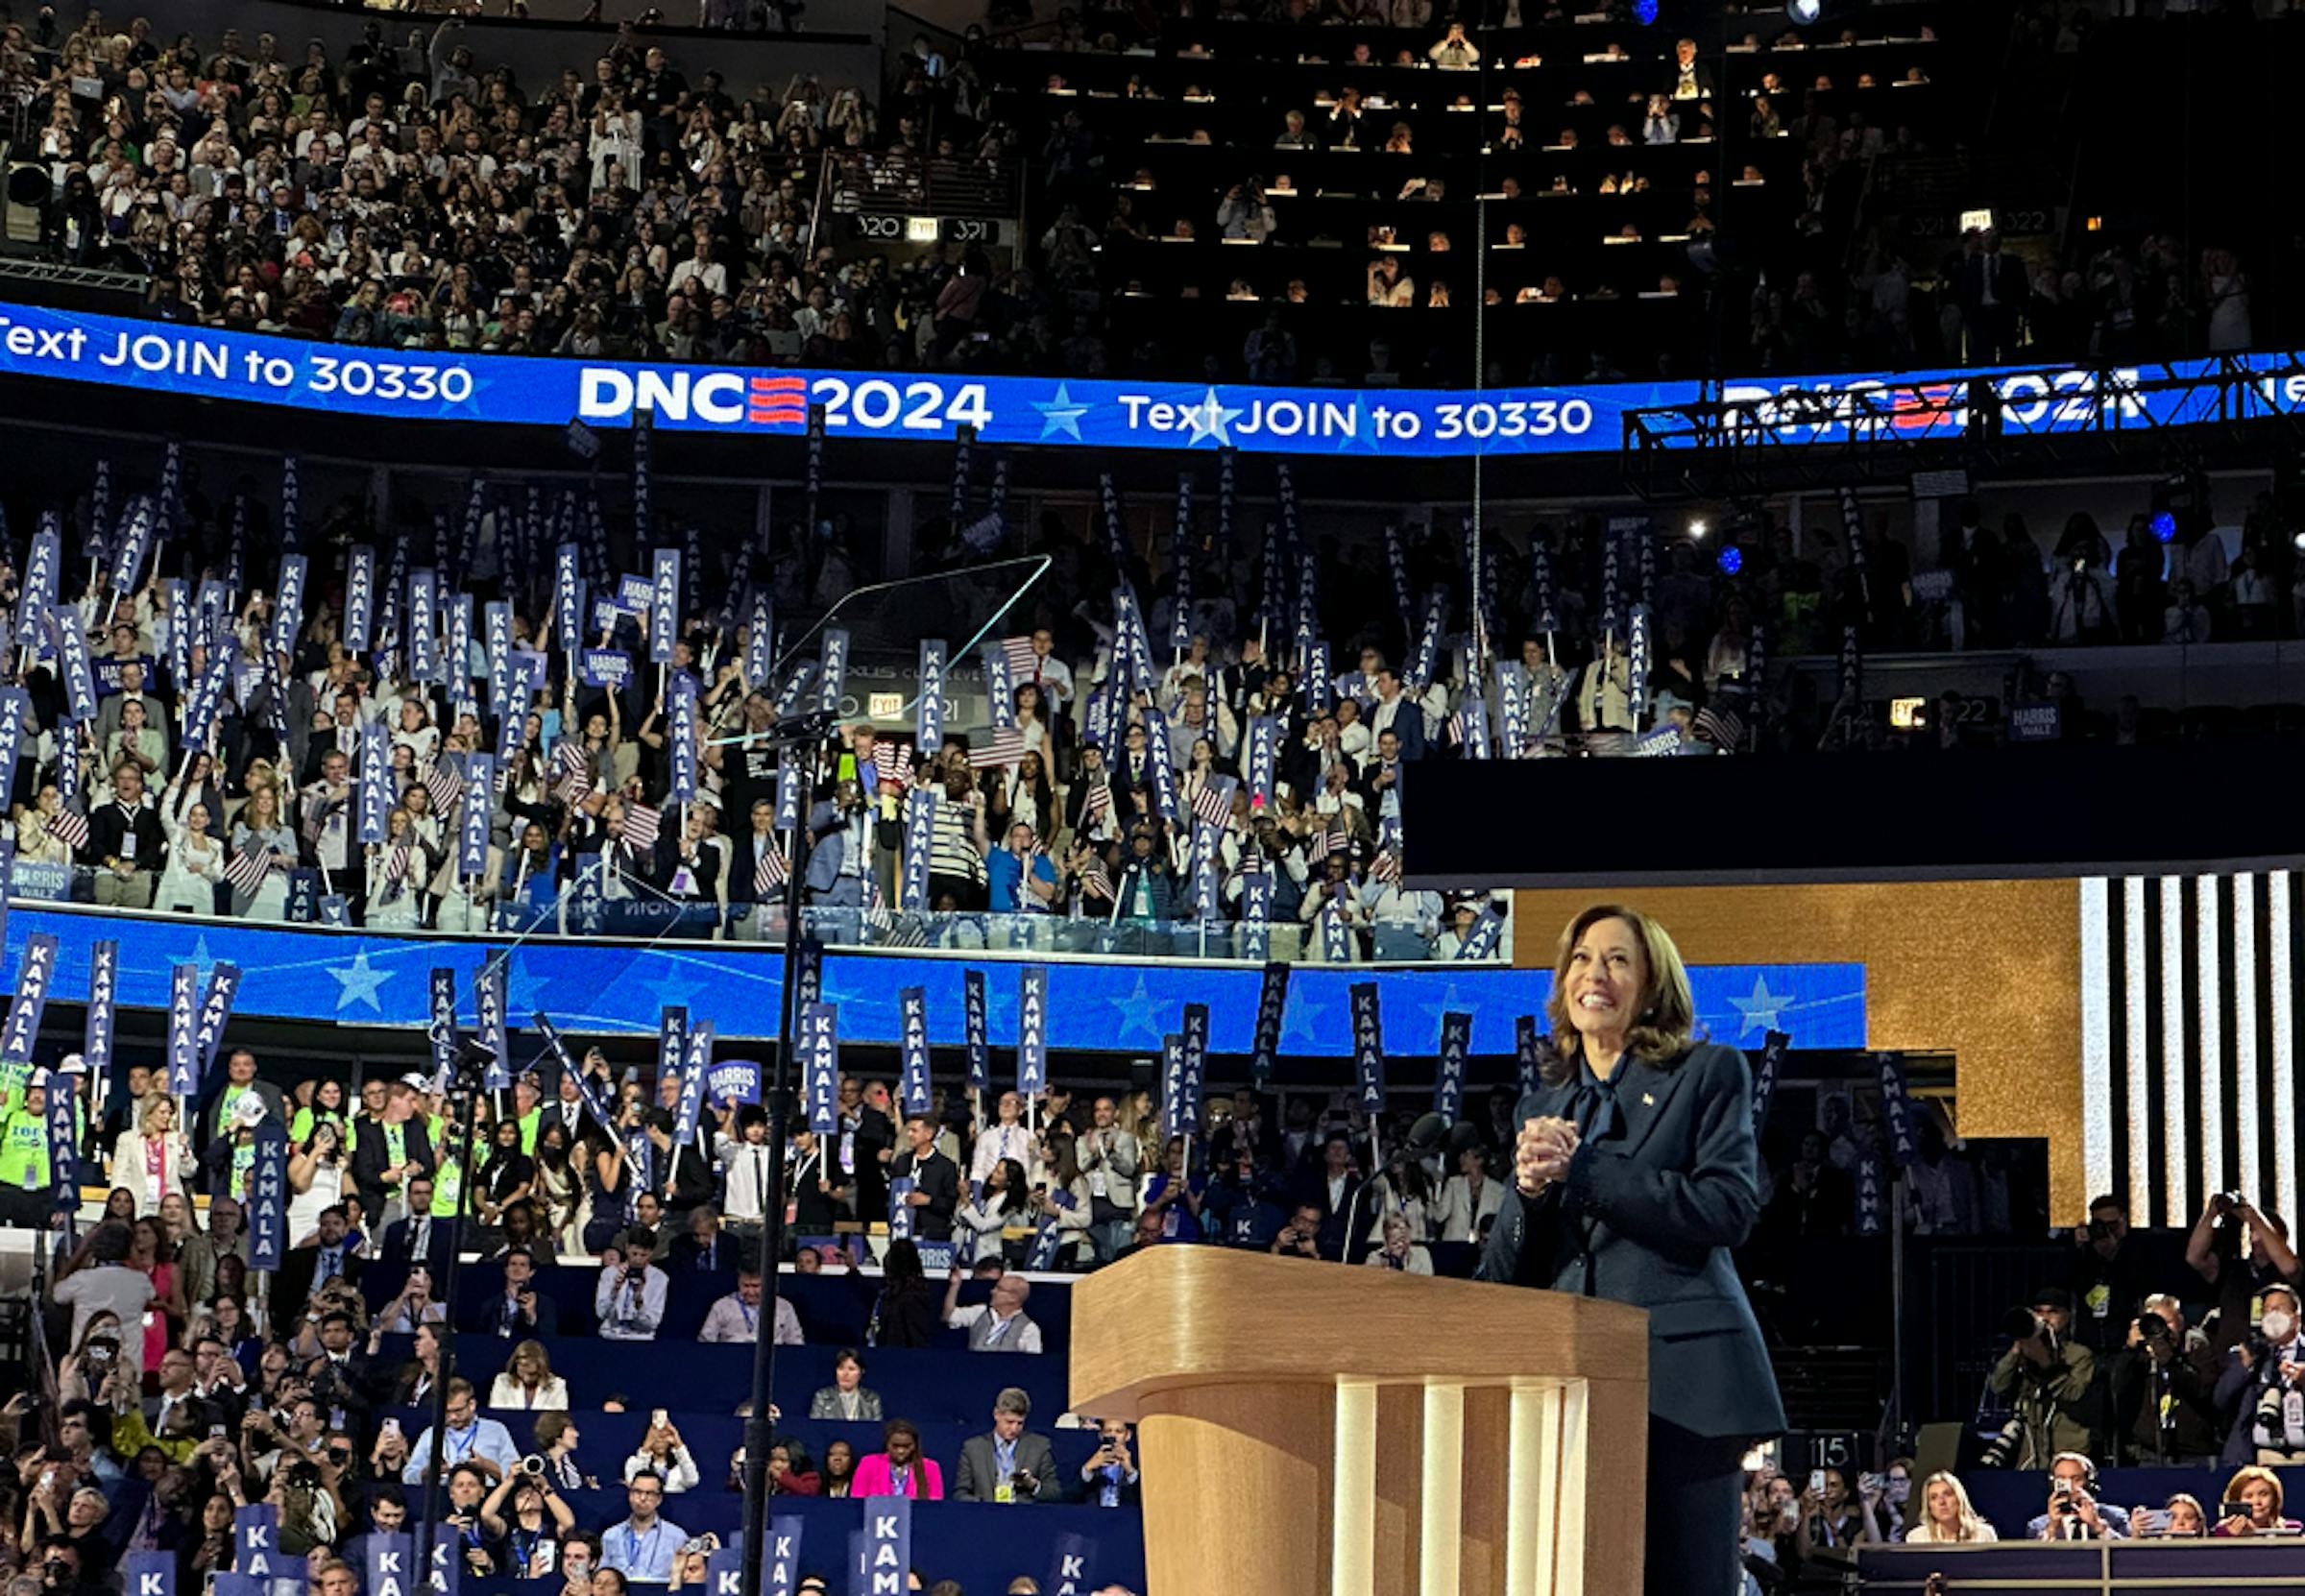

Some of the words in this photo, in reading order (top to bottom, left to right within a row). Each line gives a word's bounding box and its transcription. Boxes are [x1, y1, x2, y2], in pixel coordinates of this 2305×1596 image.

[99, 332, 228, 379] JOIN
[245, 351, 293, 386] to
[308, 355, 473, 401] 30330
[579, 369, 744, 423] DNC
[811, 379, 992, 431] 2024
[1118, 396, 1223, 433] Text
[1235, 399, 1356, 437] JOIN
[1372, 404, 1419, 439] to
[1435, 399, 1592, 439] 30330
[116, 495, 151, 580] KAMALA
[20, 545, 50, 634] KAMALA
[173, 589, 189, 679] KAMALA
[276, 567, 299, 652] KAMALA
[350, 554, 368, 641] KAMALA
[413, 584, 428, 670] KAMALA
[559, 555, 575, 639] KAMALA
[656, 560, 673, 651] KAMALA
[751, 591, 767, 677] KAMALA
[1177, 556, 1191, 638] KAMALA
[1298, 555, 1316, 636] KAMALA
[61, 617, 91, 708] KAMALA
[452, 603, 467, 692] KAMALA
[491, 614, 507, 701] KAMALA
[823, 641, 842, 711] KAMAL
[1414, 592, 1443, 677] KAMALA
[1631, 615, 1645, 704] KAMALA
[191, 645, 231, 739] KAMALA
[502, 668, 529, 759] KAMALA
[923, 651, 939, 740] KAMALA
[62, 726, 76, 796] KAMAL
[364, 737, 381, 832] KAMALA
[675, 695, 690, 789] KAMALA
[1152, 721, 1173, 808] KAMALA
[468, 765, 486, 862] KAMALA
[906, 805, 929, 898] KAMALA
[291, 879, 309, 921] KAM
[581, 866, 595, 930] KAMA
[1325, 897, 1346, 958] KAMA
[9, 945, 48, 1052] KAMALA
[92, 953, 111, 1054] KAMALA
[175, 979, 190, 1083] KAMALA
[197, 977, 230, 1047] KAMA
[480, 976, 502, 1076] KAMAA
[969, 981, 983, 1076] KAMALA
[1024, 979, 1039, 1081] KAMALA
[1255, 974, 1282, 1068] KAMALA
[677, 1032, 707, 1131] KAMALA
[708, 1067, 756, 1091] HARRIS
[815, 1016, 833, 1122] KAMALA
[907, 999, 926, 1100] KAMALA
[1183, 1016, 1202, 1121] KAMALA
[1358, 996, 1380, 1101] KAMALA
[1519, 1028, 1534, 1095] KAMA
[1752, 1044, 1780, 1113] KAMA
[53, 1089, 74, 1199] KAMALA
[255, 1141, 278, 1256] KAMALA
[1860, 1160, 1880, 1230] KAMA
[873, 1516, 900, 1595] KAM
